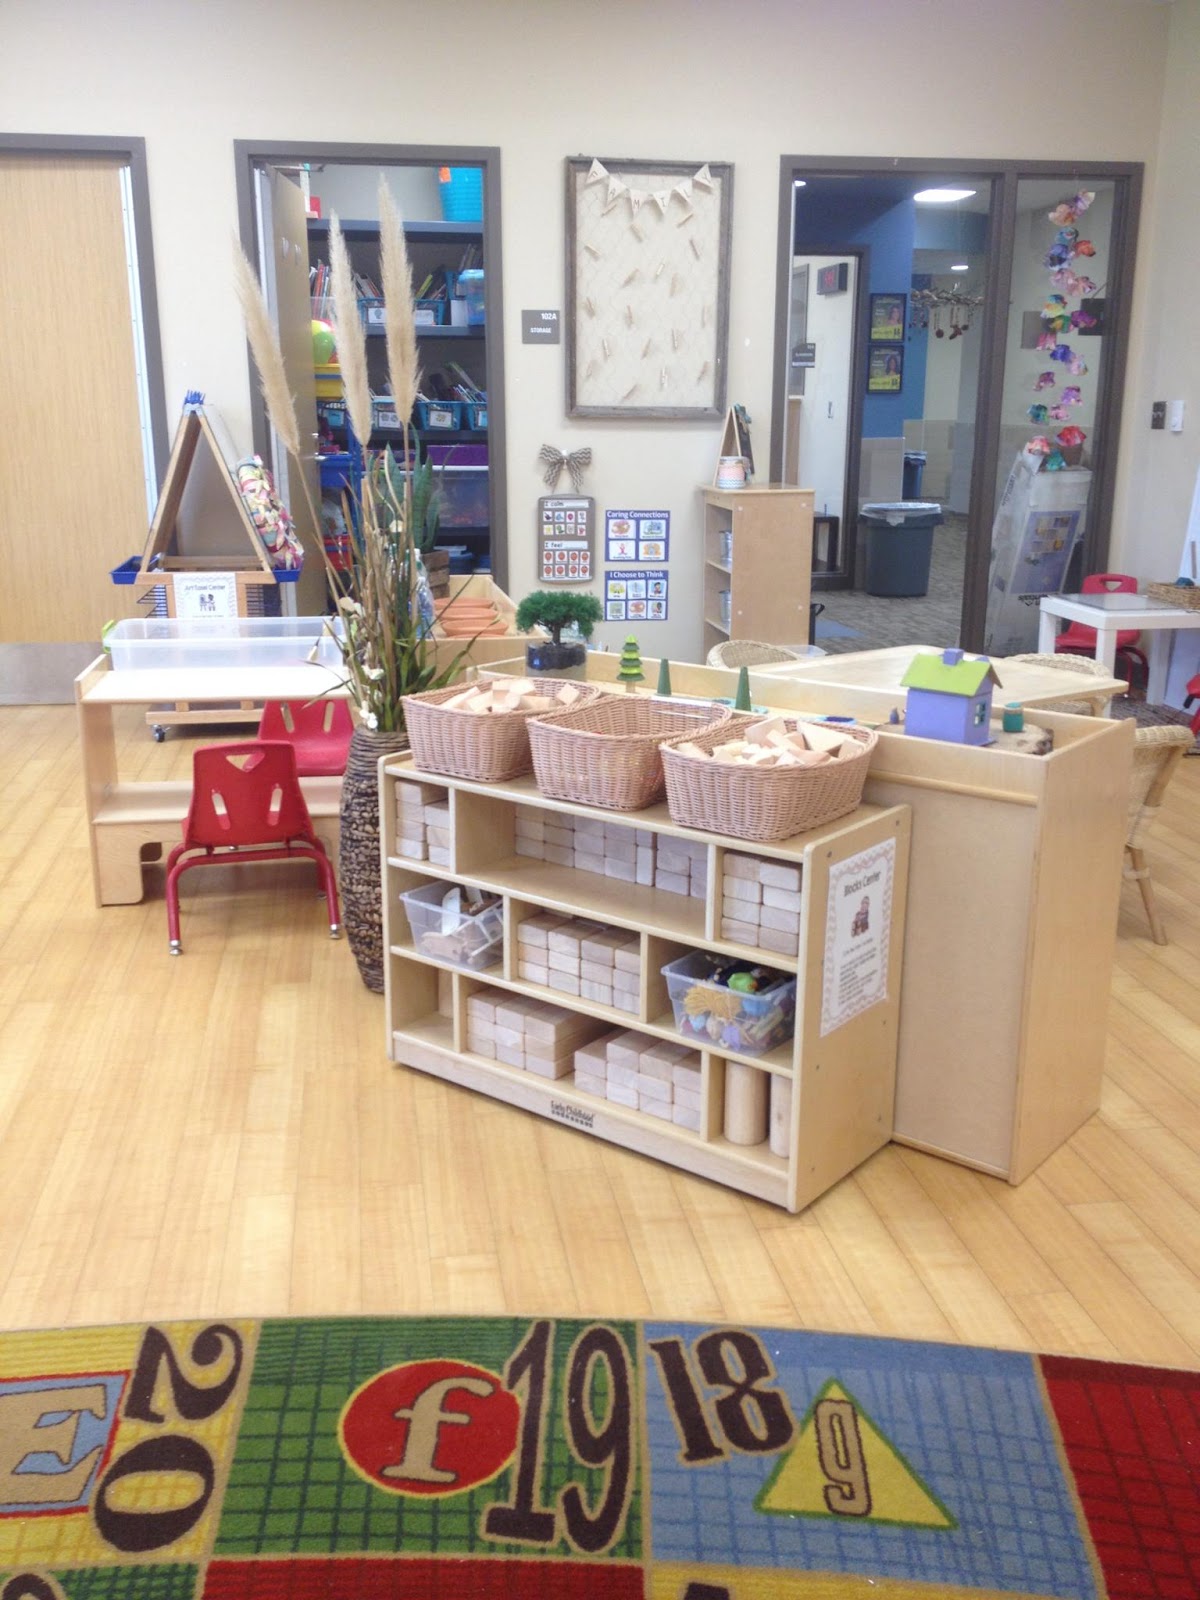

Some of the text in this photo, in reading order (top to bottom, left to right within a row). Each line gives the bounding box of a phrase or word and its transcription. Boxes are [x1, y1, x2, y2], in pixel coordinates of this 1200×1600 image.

[541, 312, 557, 320] 102A
[606, 511, 629, 519] Caring
[843, 870, 882, 898] Blocks Center
[381, 1376, 496, 1484] f
[649, 1331, 794, 1462] 18
[485, 1320, 631, 1552] 19
